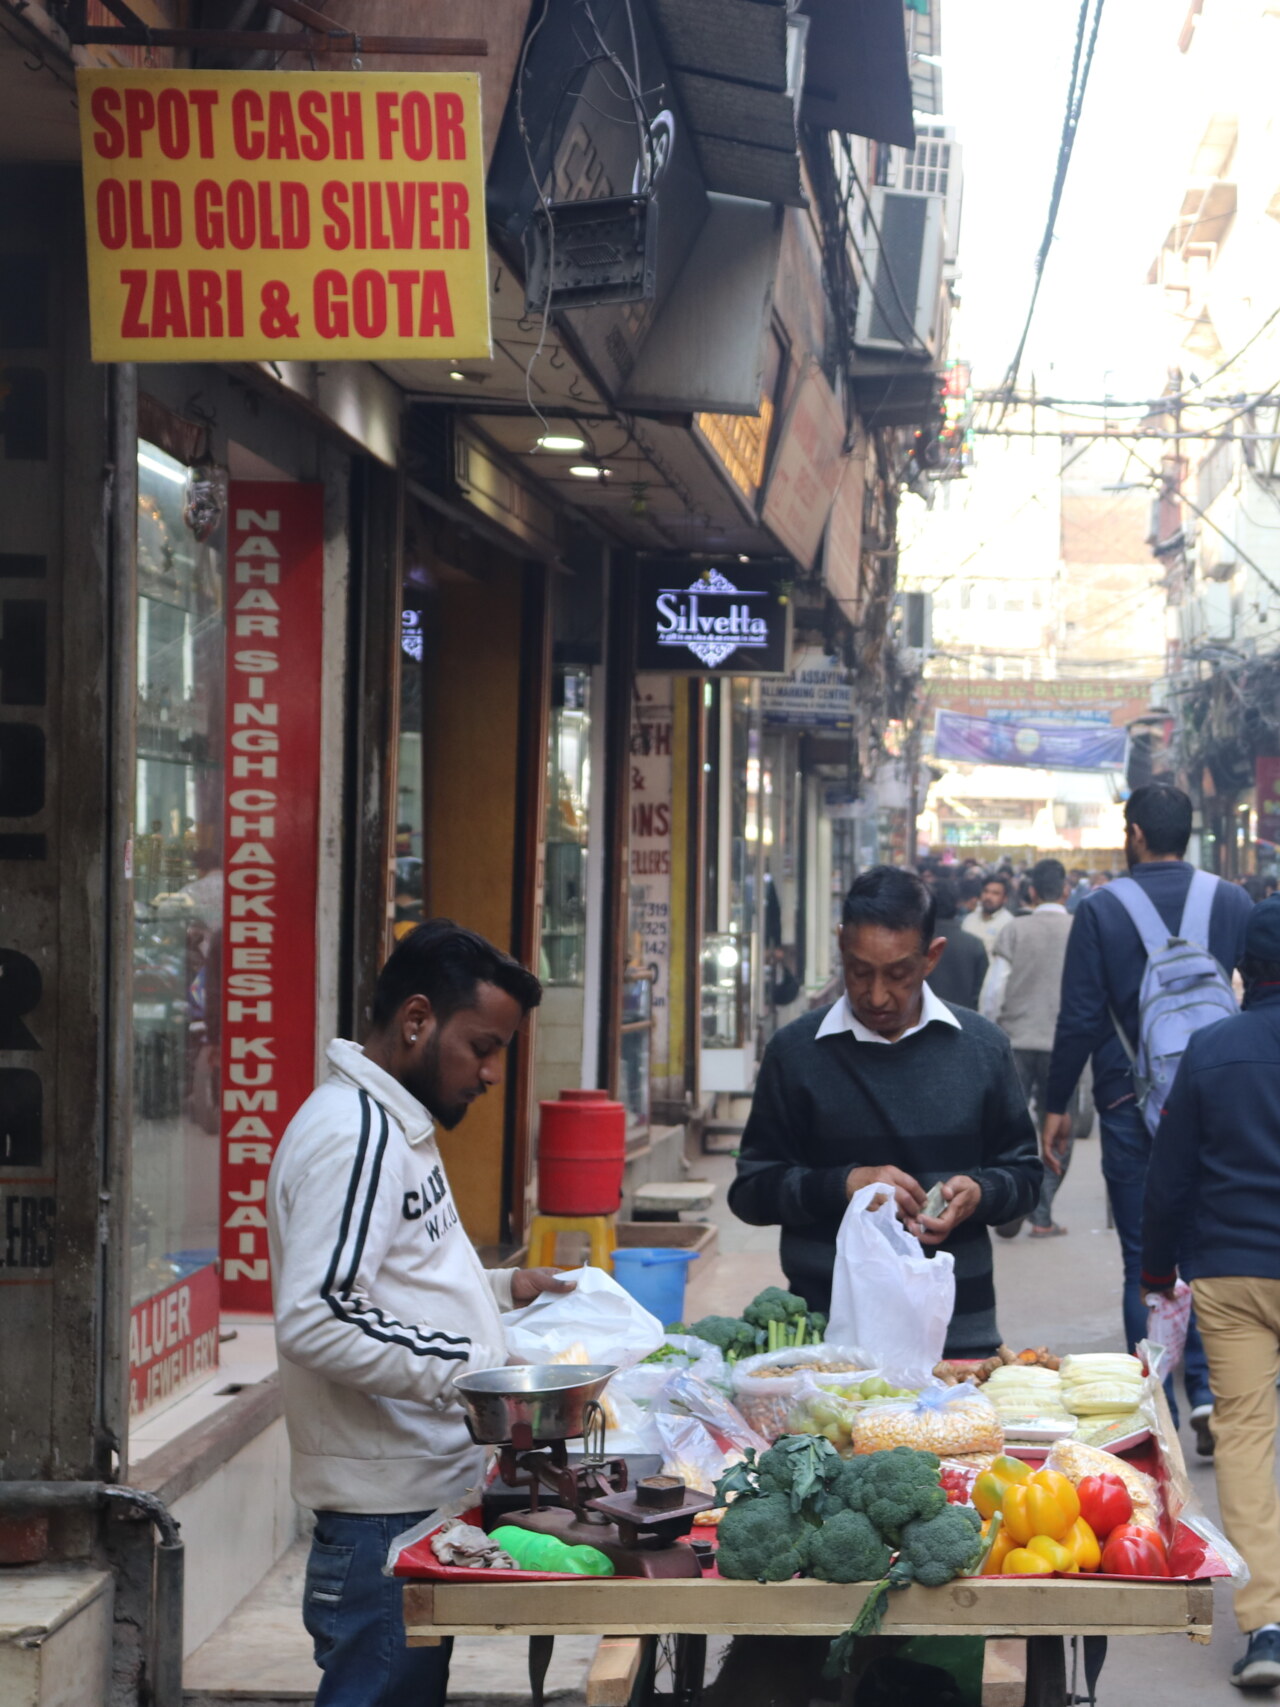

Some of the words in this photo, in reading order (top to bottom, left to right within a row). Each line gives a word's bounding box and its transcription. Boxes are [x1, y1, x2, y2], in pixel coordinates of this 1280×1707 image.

[91, 86, 219, 160] SPOT
[231, 88, 364, 161] CASH
[376, 90, 466, 162] FOR
[97, 177, 183, 251] OLD
[194, 178, 311, 251] GOLD
[322, 180, 470, 251] SILVER
[120, 269, 244, 339] ZARI
[259, 279, 300, 339] &
[313, 268, 455, 339] GOTA
[233, 509, 280, 637] NAHAR
[656, 593, 768, 634] Silvetta
[231, 649, 280, 778] SINGH
[761, 686, 814, 698] ALLMARKING
[800, 669, 852, 685] ASSAYIN
[1113, 683, 1151, 698] KAL
[632, 802, 670, 837] NS
[227, 789, 276, 1022] CHACKRESH
[223, 1036, 277, 1164] KUMAR
[0, 1195, 57, 1268] ERS
[224, 1180, 269, 1281] JAIN
[129, 1285, 191, 1367] ALUER
[143, 1326, 218, 1409] JEWELLERY
